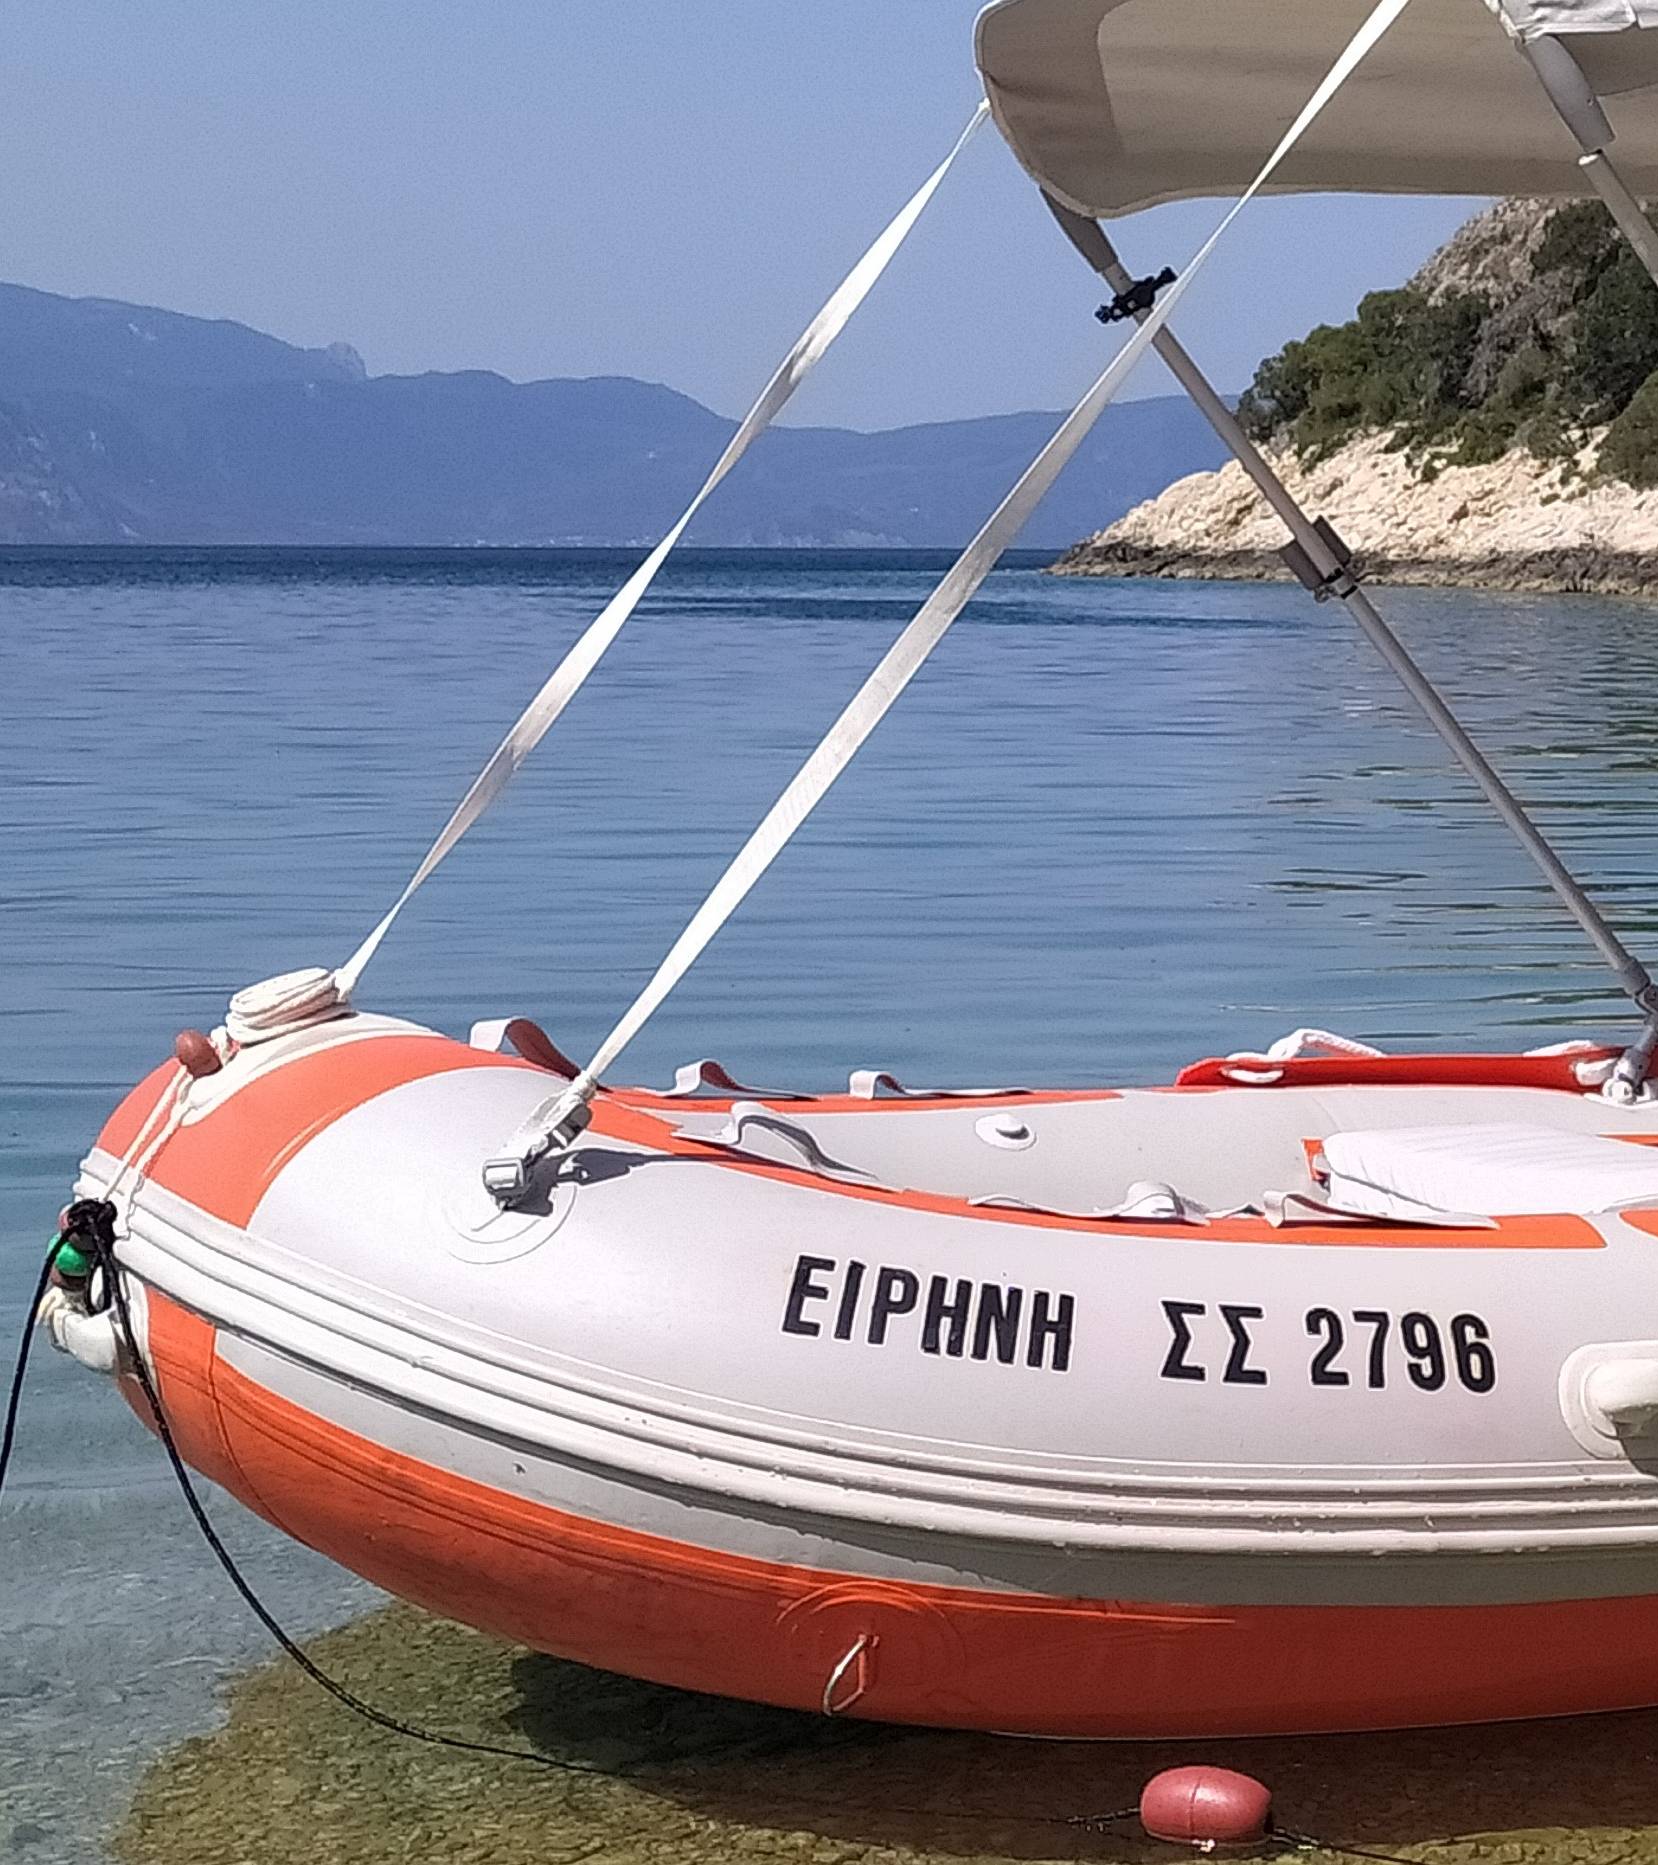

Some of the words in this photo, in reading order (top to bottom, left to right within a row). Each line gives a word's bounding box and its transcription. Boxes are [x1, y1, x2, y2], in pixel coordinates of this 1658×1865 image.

[781, 1255, 1075, 1372] ΕΙΡΗΝΗ
[1160, 1300, 1267, 1385] ΣΣ
[1306, 1307, 1496, 1394] 2796
